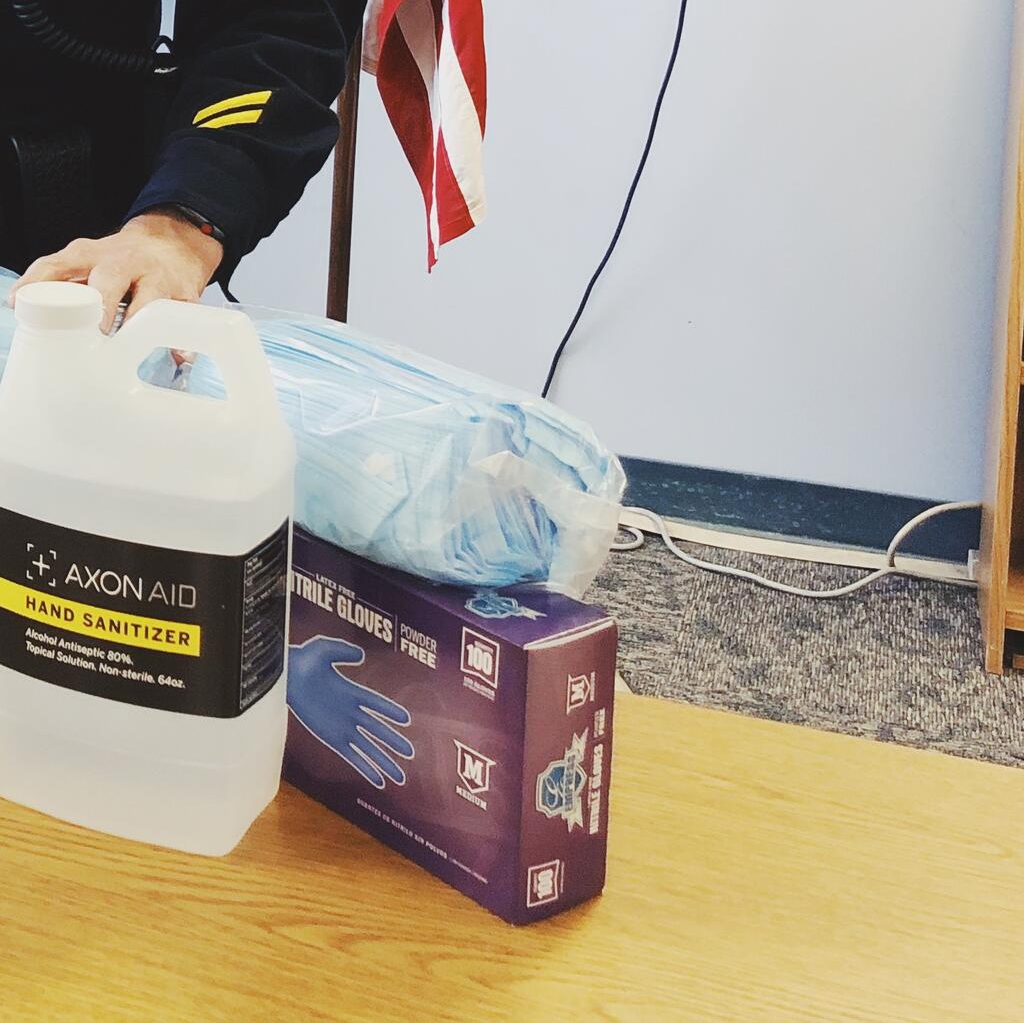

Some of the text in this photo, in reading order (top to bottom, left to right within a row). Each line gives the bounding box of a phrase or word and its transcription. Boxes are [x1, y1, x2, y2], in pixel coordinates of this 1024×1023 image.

[65, 563, 196, 609] AXON AID
[315, 574, 356, 600] LATEX FREE
[25, 595, 191, 646] HAND SANITIZER
[337, 595, 393, 644] GLOVES
[400, 623, 437, 653] POWDER
[25, 627, 134, 666] Alcohol Antiseptic 80%.
[400, 637, 437, 669] FREE
[467, 644, 493, 675] 100
[25, 641, 187, 690] Topical Solution. Non-sterile. 64oz.
[464, 752, 484, 787] M
[564, 755, 576, 813] EMPRESS
[455, 785, 488, 811] MEDIUM
